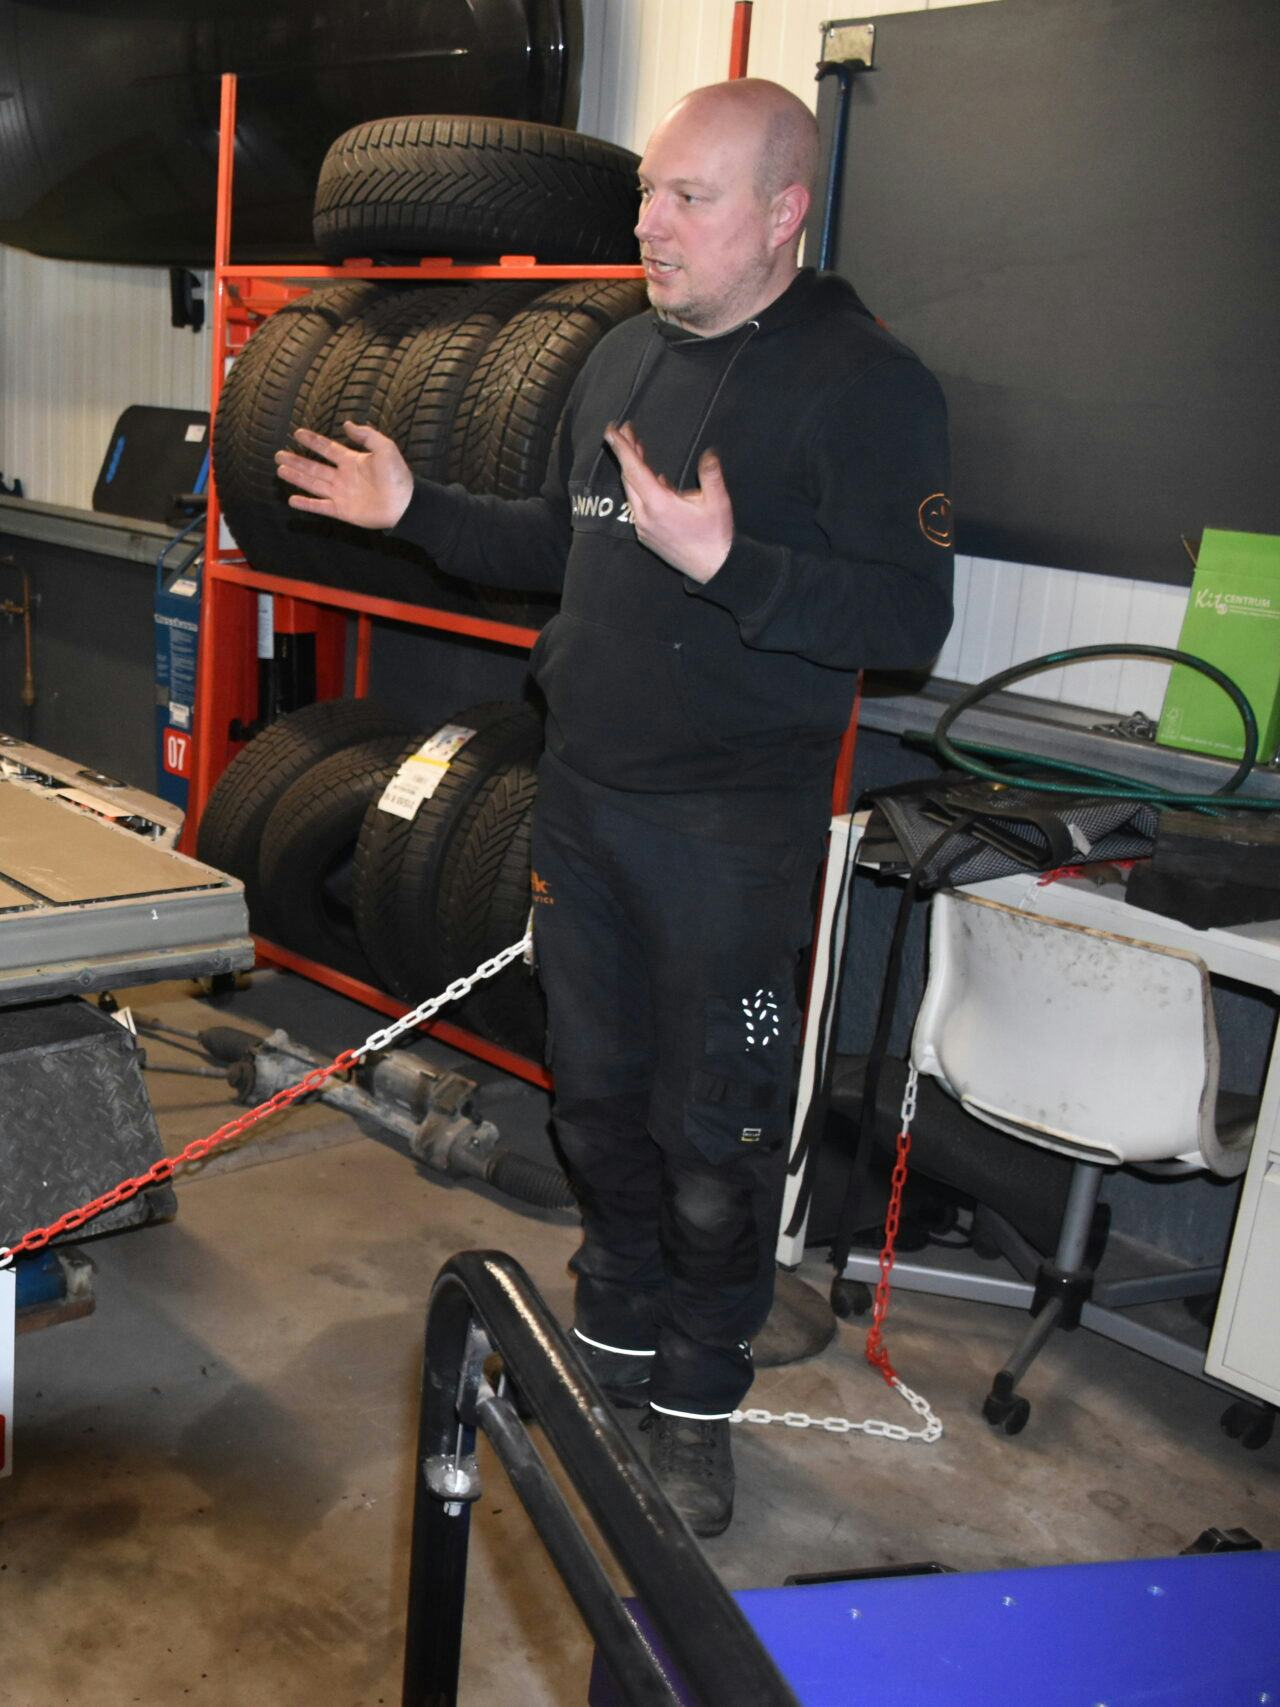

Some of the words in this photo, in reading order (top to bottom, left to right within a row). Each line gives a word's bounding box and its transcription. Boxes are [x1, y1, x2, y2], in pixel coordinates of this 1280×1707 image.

[572, 494, 614, 517] ANNO
[1224, 594, 1271, 608] CENTRUM
[168, 736, 186, 771] 07
